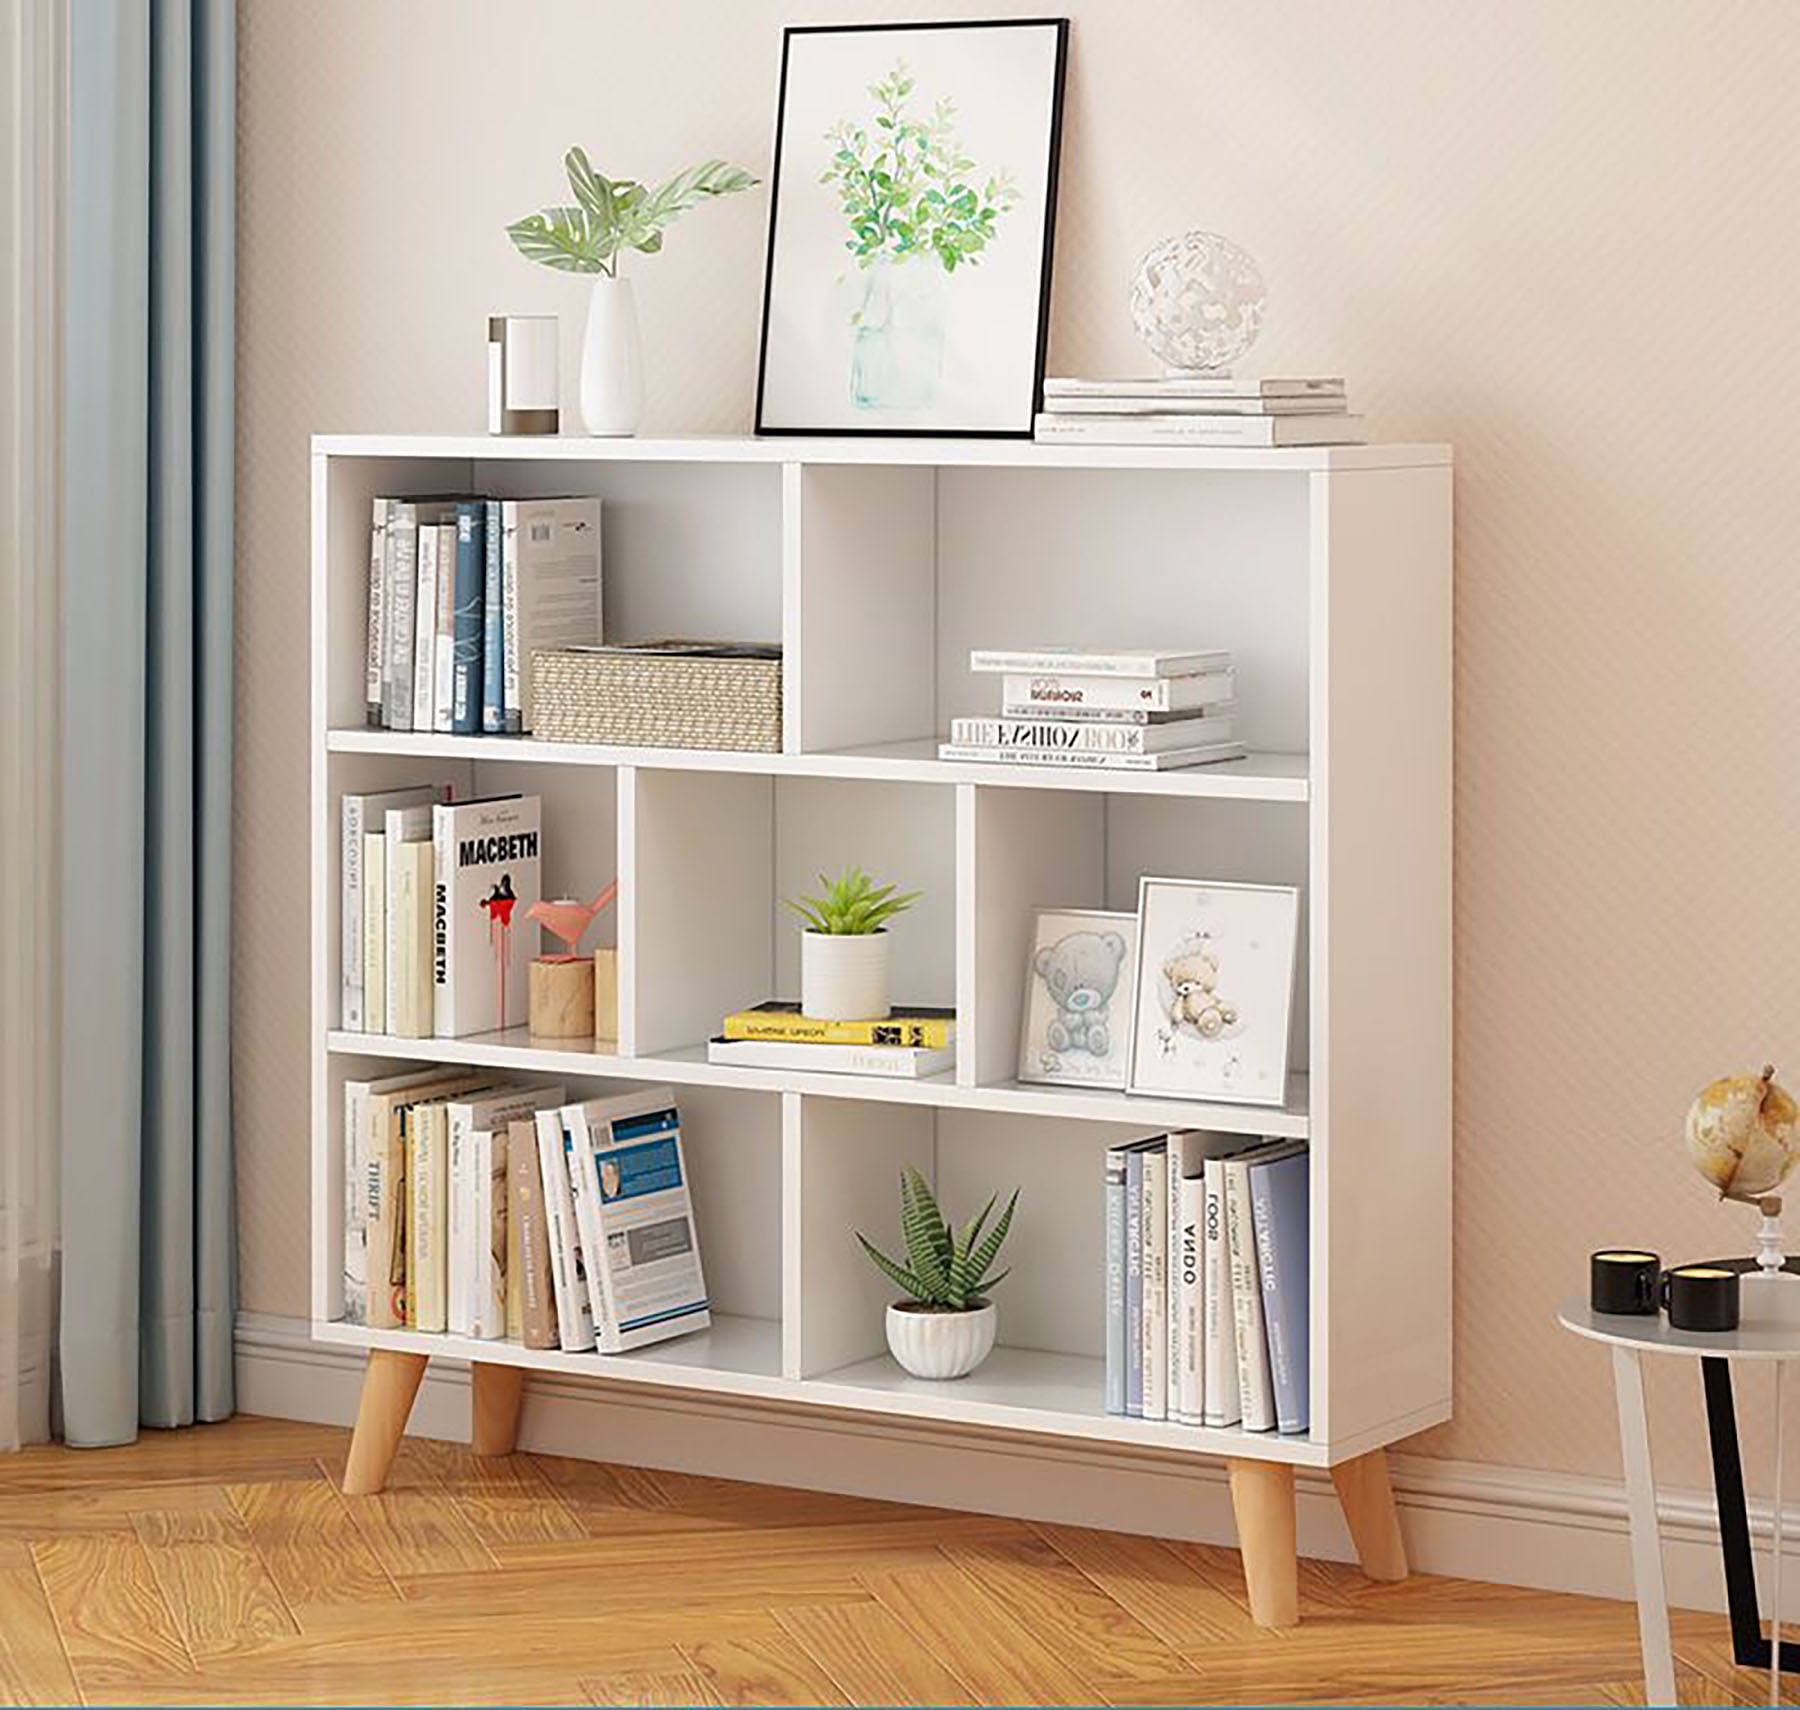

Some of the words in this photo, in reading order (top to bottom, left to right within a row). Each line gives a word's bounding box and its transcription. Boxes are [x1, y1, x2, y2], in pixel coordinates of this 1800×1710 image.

[459, 832, 538, 867] MACBETH
[435, 884, 447, 985] MACBETH
[368, 1160, 381, 1222] THRIFT
